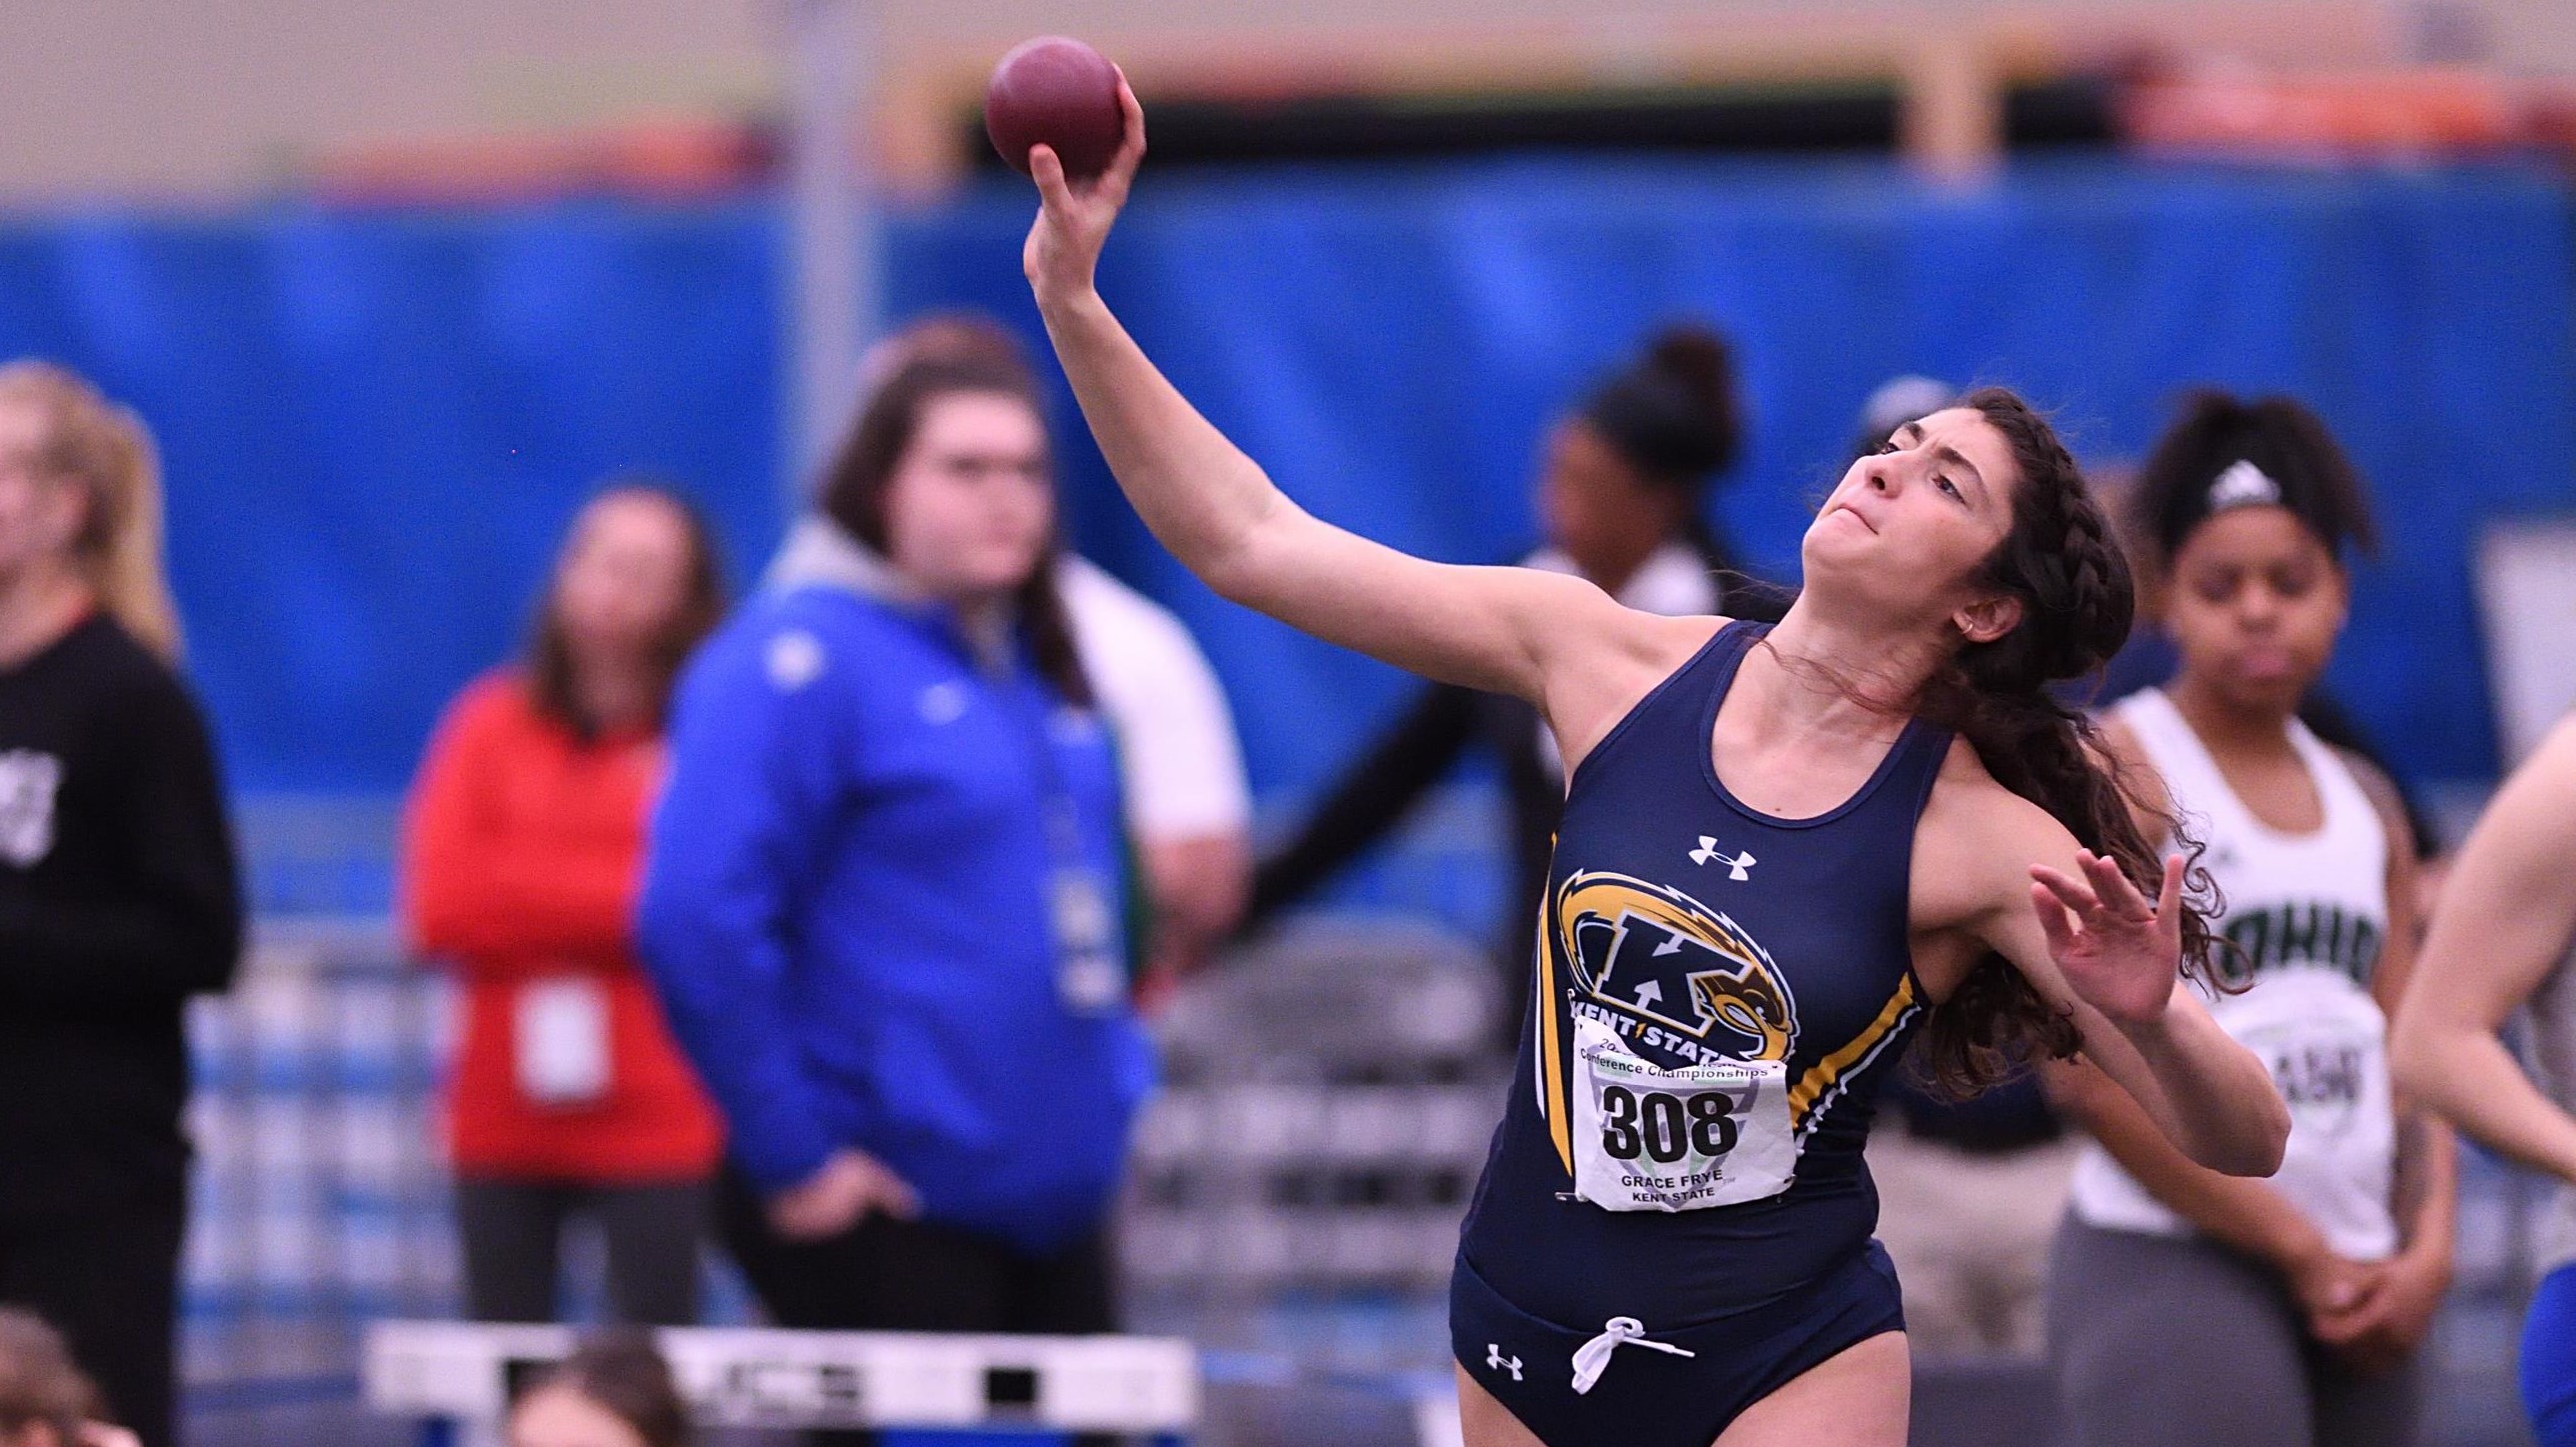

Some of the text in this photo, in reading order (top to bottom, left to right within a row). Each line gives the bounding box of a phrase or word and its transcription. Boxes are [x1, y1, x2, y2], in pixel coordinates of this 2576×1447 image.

[1570, 1001, 1637, 1036] KENT
[1580, 1048, 1768, 1081] Conference Championships
[1603, 1085, 1738, 1163] 308
[1621, 1169, 1723, 1188] GRACE FRYE
[1632, 1187, 1715, 1203] KENT STATE
